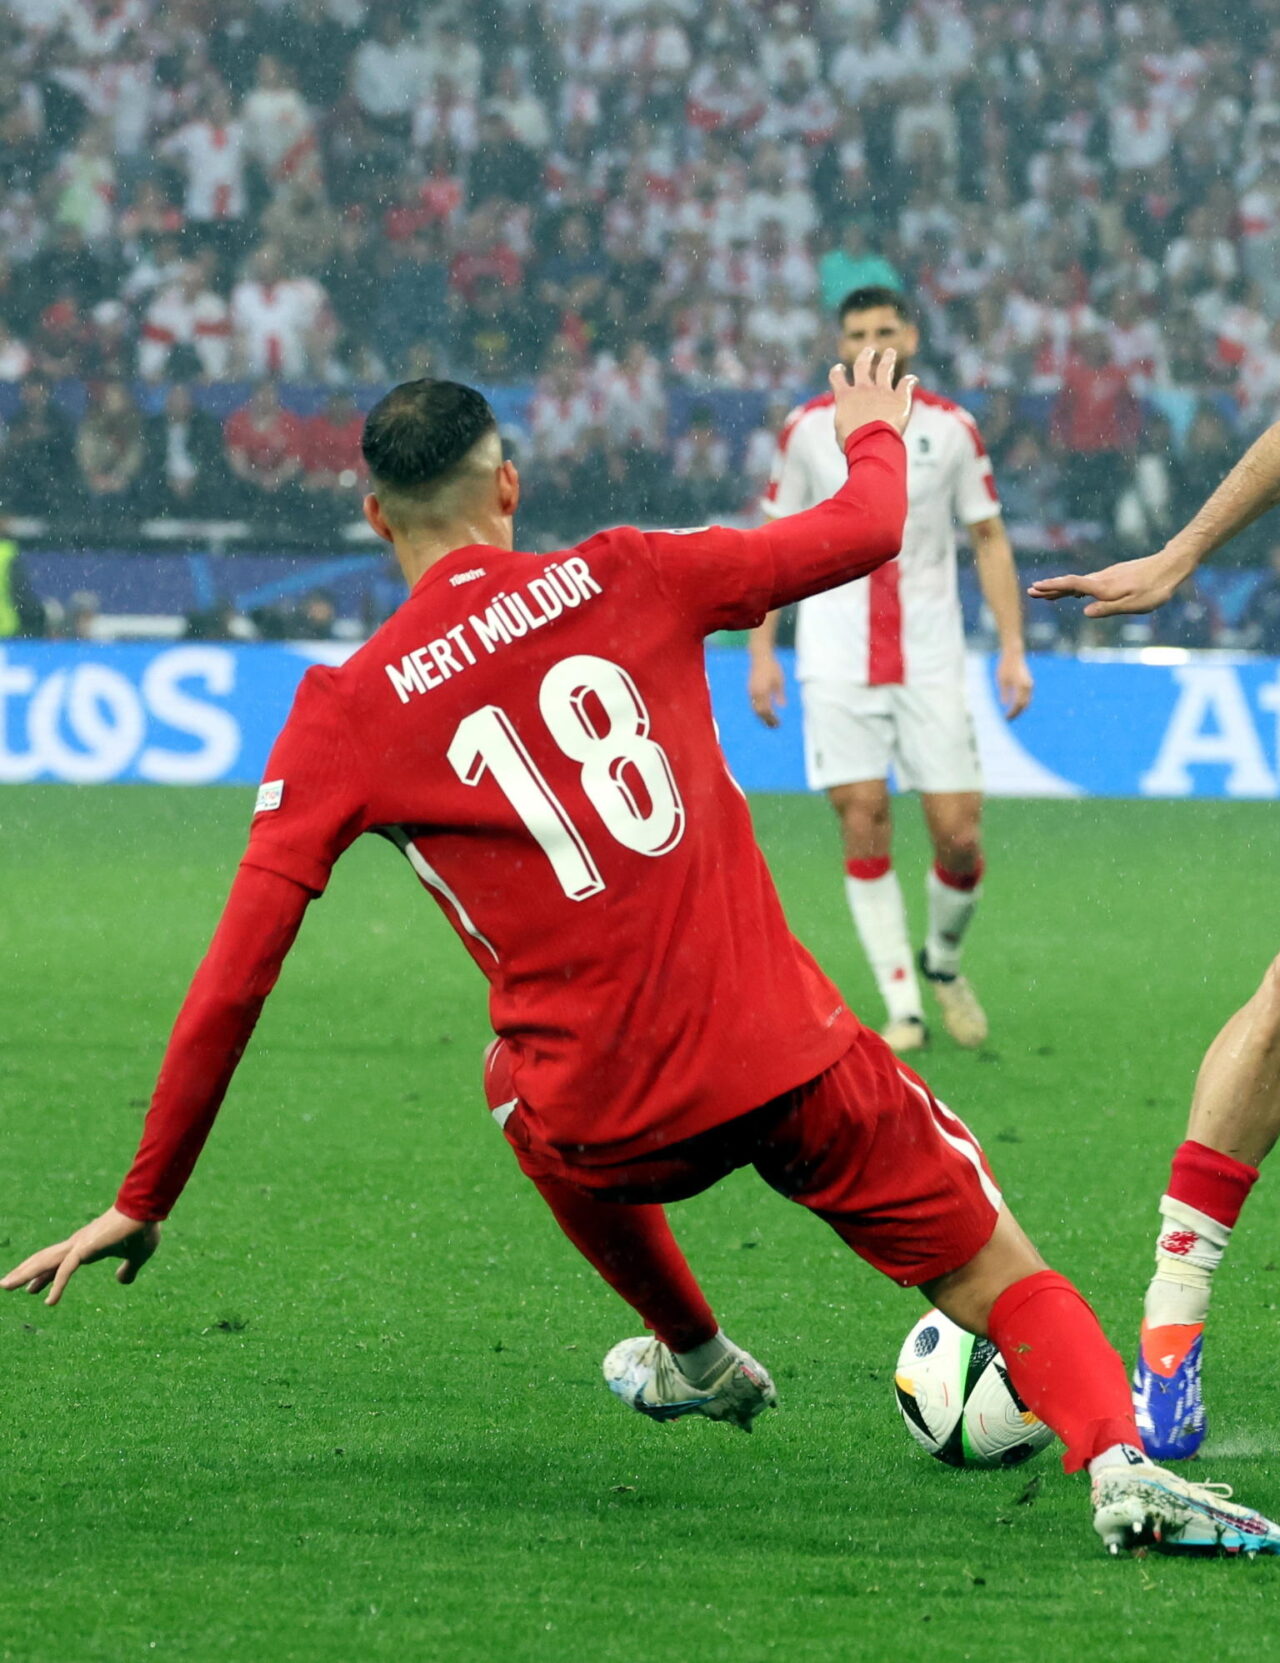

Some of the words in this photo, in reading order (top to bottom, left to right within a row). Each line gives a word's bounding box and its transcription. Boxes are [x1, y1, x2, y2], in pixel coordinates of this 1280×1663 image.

[385, 623, 477, 704] MERT
[468, 556, 603, 654] MÜLDÜR
[446, 654, 686, 902] 18
